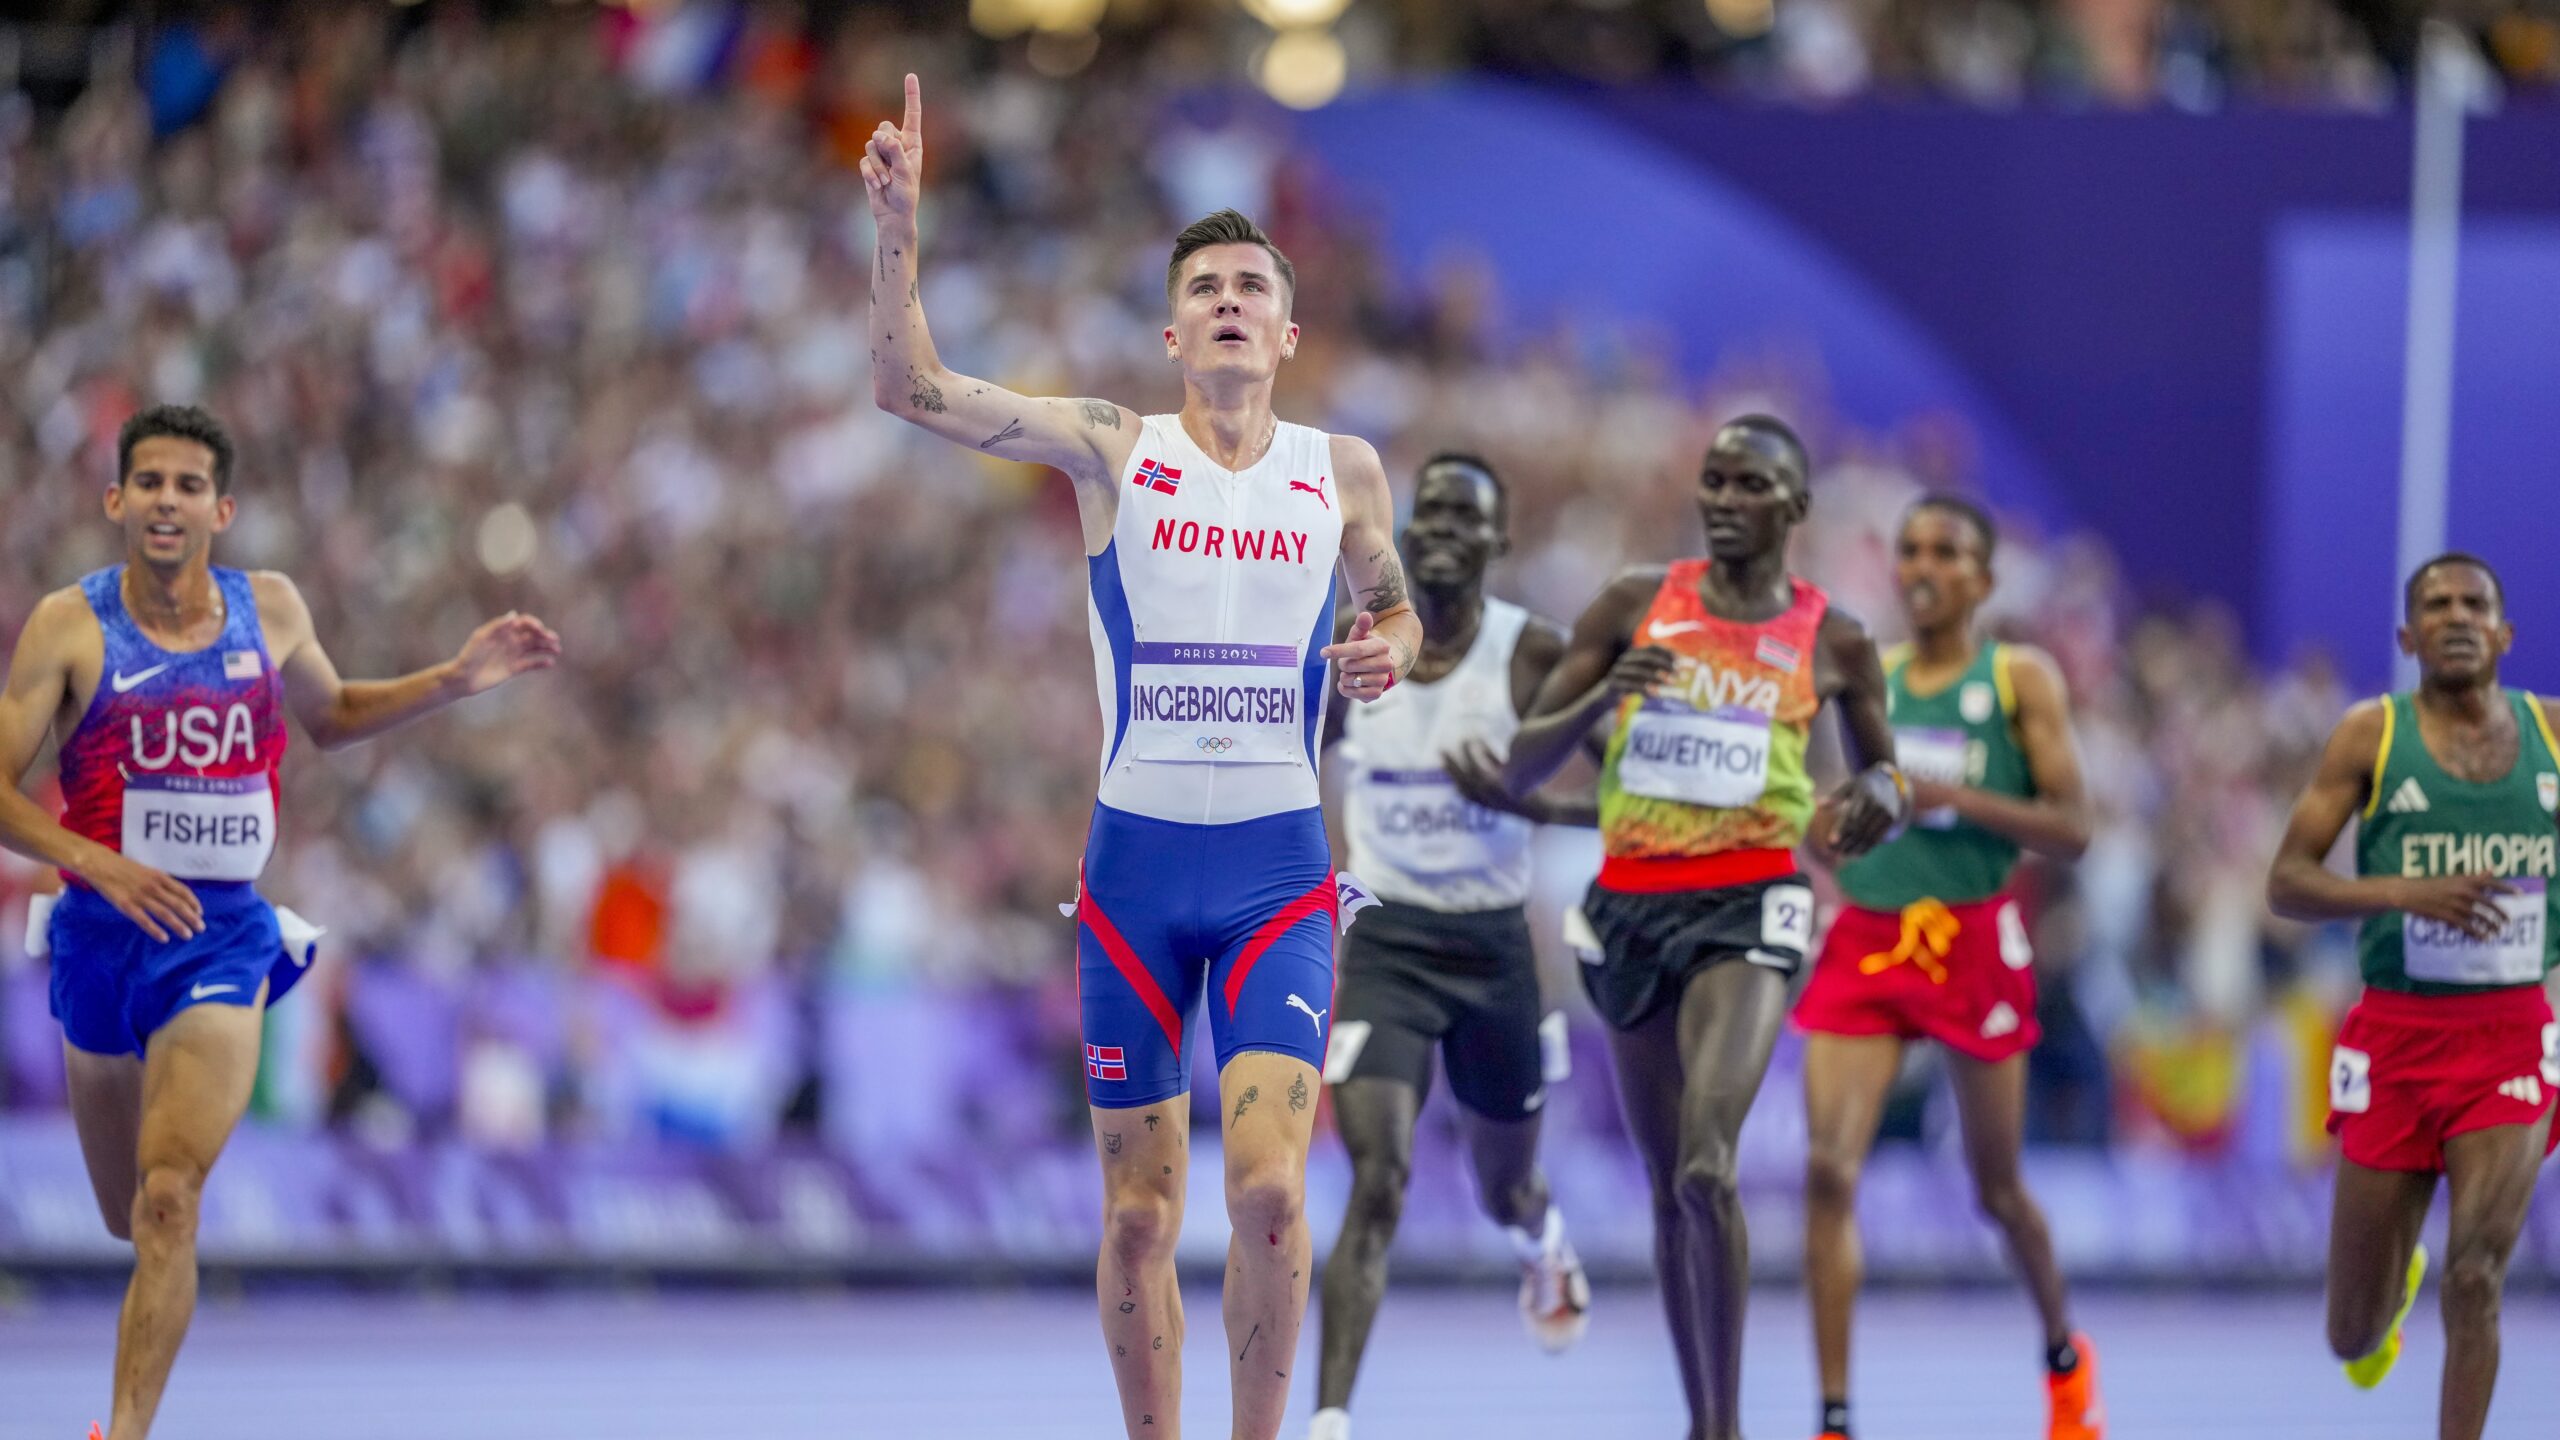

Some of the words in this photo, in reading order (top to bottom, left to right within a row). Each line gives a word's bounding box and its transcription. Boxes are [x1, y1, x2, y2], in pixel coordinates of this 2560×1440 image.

[1151, 518, 1308, 564] NORWAY
[1174, 648, 1216, 659] PARIS
[1221, 649, 1257, 660] 2024
[1133, 684, 1296, 724] INGEBRIGTSEN
[1657, 656, 1781, 718] ENYA
[130, 702, 256, 770] USA
[1632, 729, 1763, 776] KWEMOI
[144, 810, 260, 846] FISHER
[2402, 832, 2556, 879] ETHIOPIA
